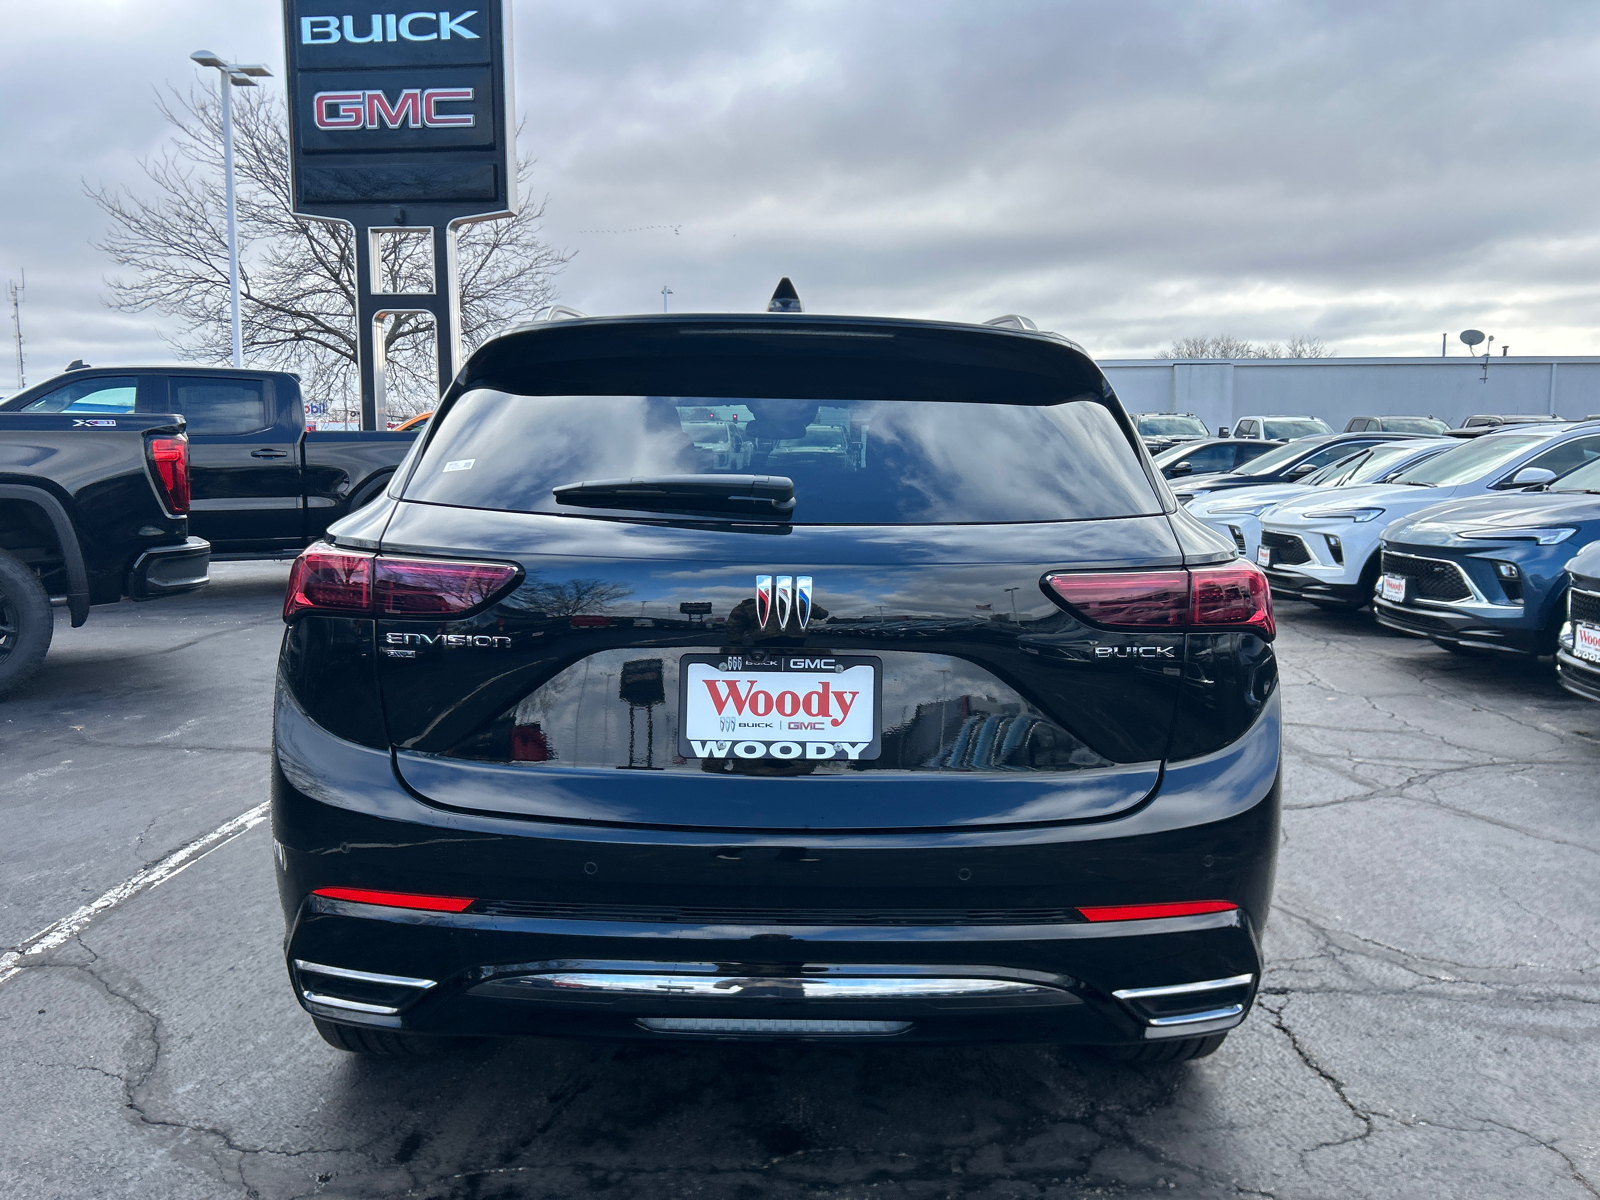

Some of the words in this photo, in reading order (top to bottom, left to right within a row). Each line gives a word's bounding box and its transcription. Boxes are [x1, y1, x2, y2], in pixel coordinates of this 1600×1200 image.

[301, 10, 481, 45] BUICK
[314, 87, 475, 131] GMC
[304, 403, 325, 413] obil
[1095, 646, 1175, 658] BUICK
[789, 658, 836, 669] GMC
[702, 679, 859, 727] Woody
[788, 721, 825, 731] GMC
[690, 740, 870, 760] WOODY
